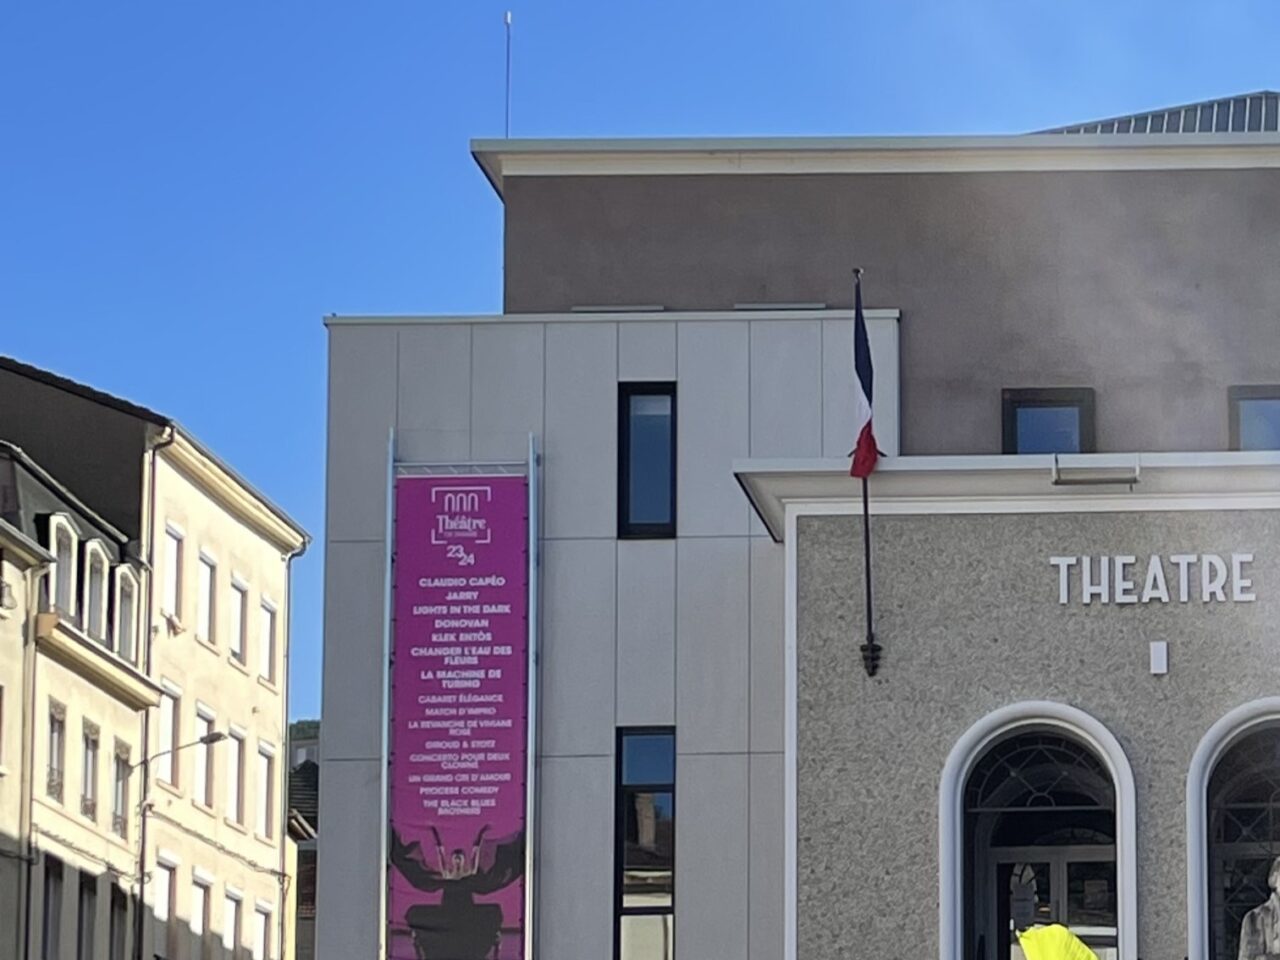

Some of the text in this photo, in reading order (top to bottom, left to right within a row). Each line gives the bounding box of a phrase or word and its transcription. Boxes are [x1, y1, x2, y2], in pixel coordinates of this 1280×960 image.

[436, 514, 486, 534] Théâtre
[446, 545, 475, 566] 23 24
[419, 574, 506, 587] CLAUDIO CAPÉO
[1049, 553, 1256, 604] THEATRE
[445, 591, 478, 600] JARRY
[413, 604, 511, 615] LIGHTS IN THE DARK
[434, 619, 489, 628] DONOVAN
[410, 646, 512, 656] CHANGER L'EAU DES
[444, 656, 478, 665] FLEURS
[421, 669, 501, 679] LA MACHINE DE
[418, 695, 457, 703] CABARET
[408, 721, 418, 729] LA
[440, 799, 469, 807] BLACK
